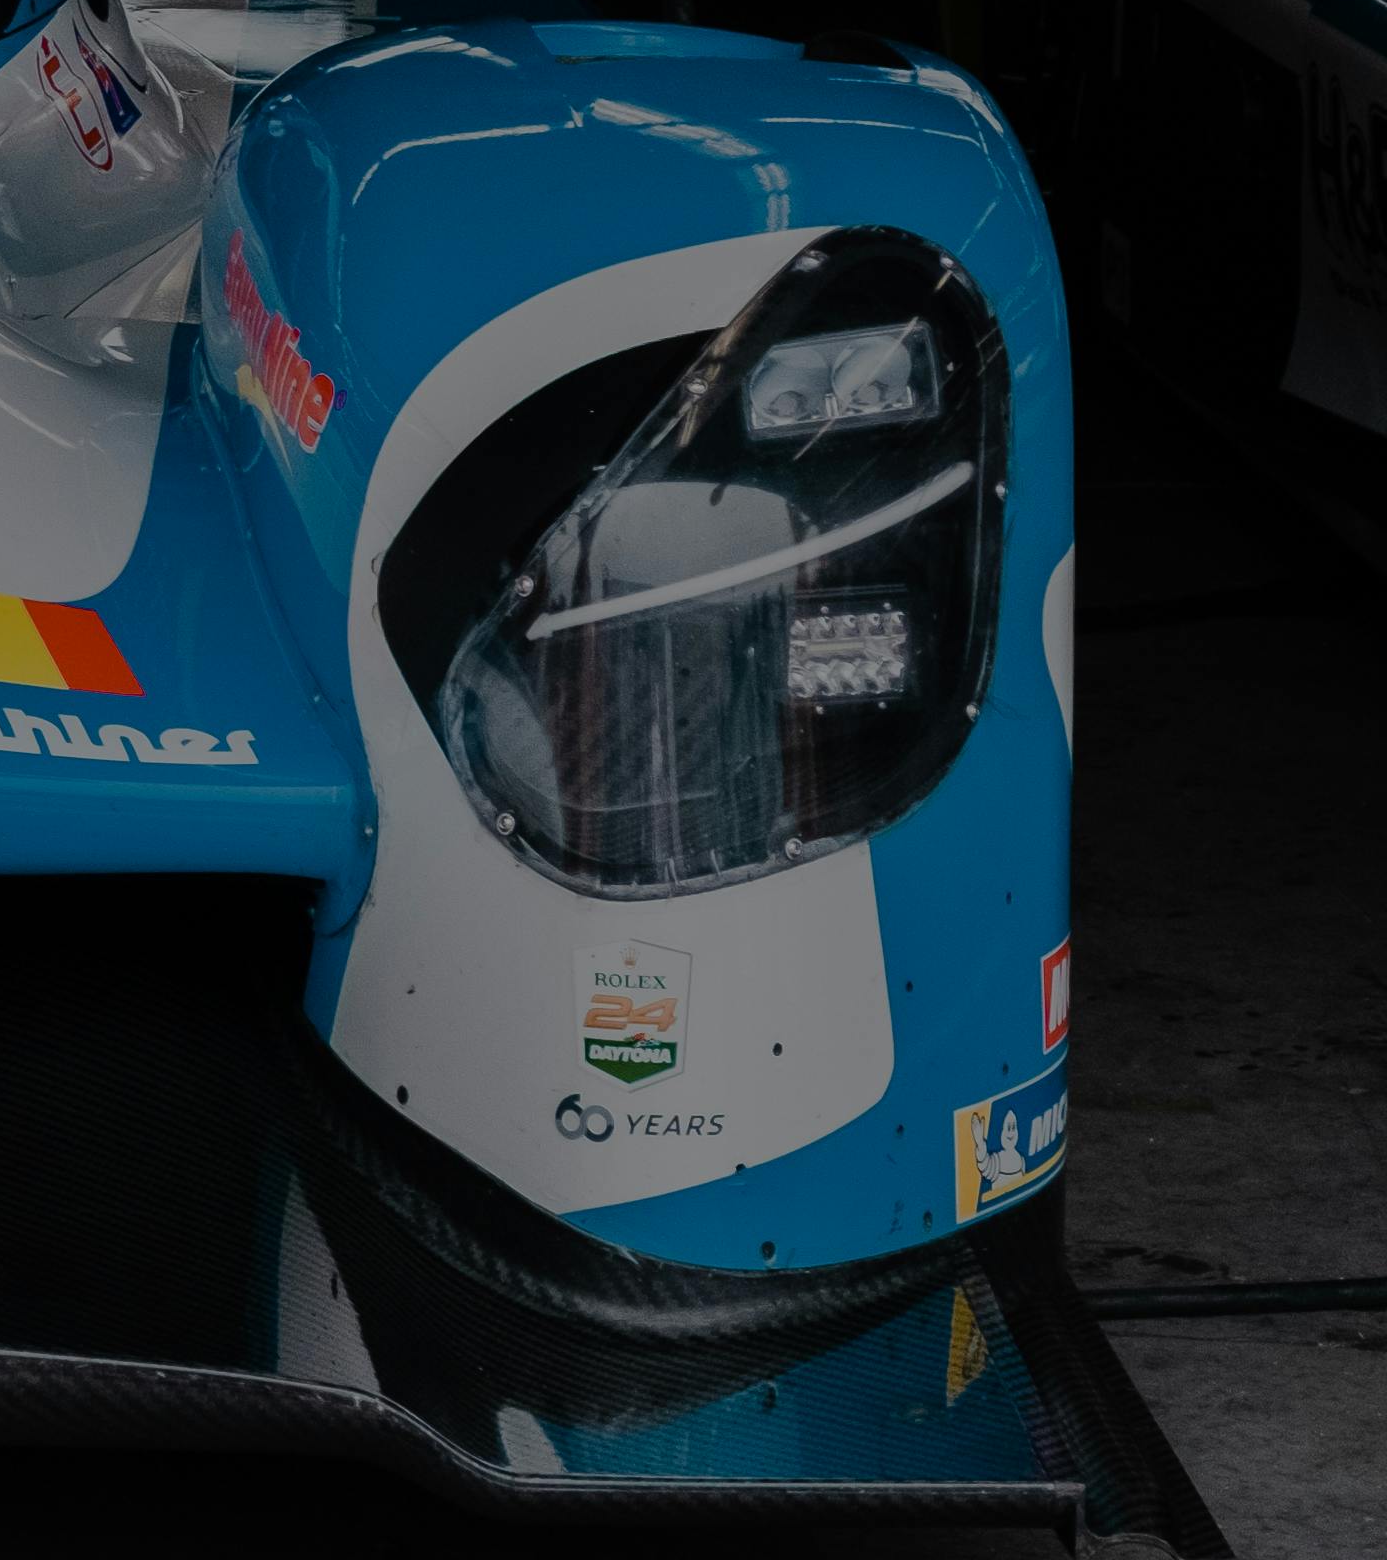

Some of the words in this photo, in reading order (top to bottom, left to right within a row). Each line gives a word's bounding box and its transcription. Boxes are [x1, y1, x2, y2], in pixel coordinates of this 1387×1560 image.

[593, 972, 668, 990] ROLEX
[583, 994, 678, 1032] 24
[588, 1044, 673, 1064] DAYTONA
[555, 1093, 615, 1143] 60
[626, 1114, 725, 1136] YEARS
